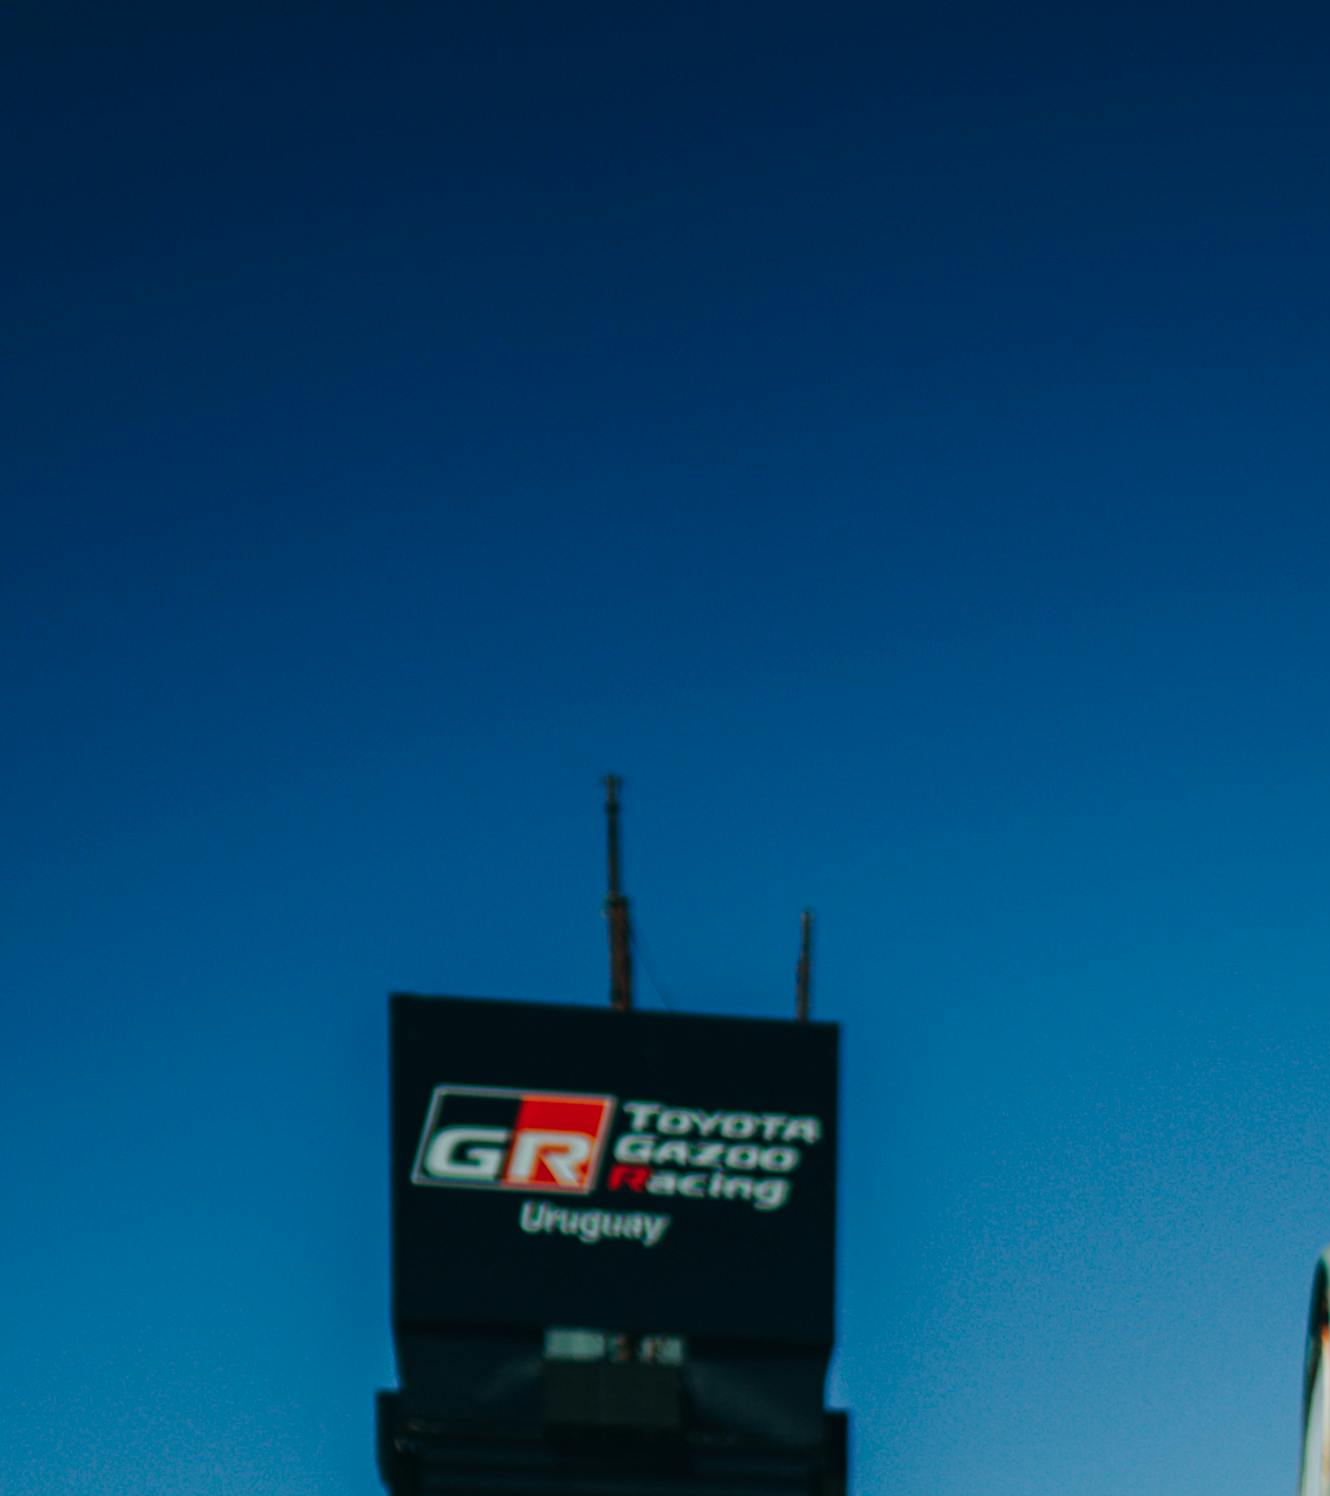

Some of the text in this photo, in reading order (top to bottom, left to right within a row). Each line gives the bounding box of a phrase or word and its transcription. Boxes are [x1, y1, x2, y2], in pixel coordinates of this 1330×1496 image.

[624, 1102, 821, 1143] TOYOTA
[426, 1128, 588, 1186] GR
[614, 1135, 799, 1171] GAZOO
[609, 1164, 790, 1210] Racing
[520, 1201, 668, 1246] Uruguay
